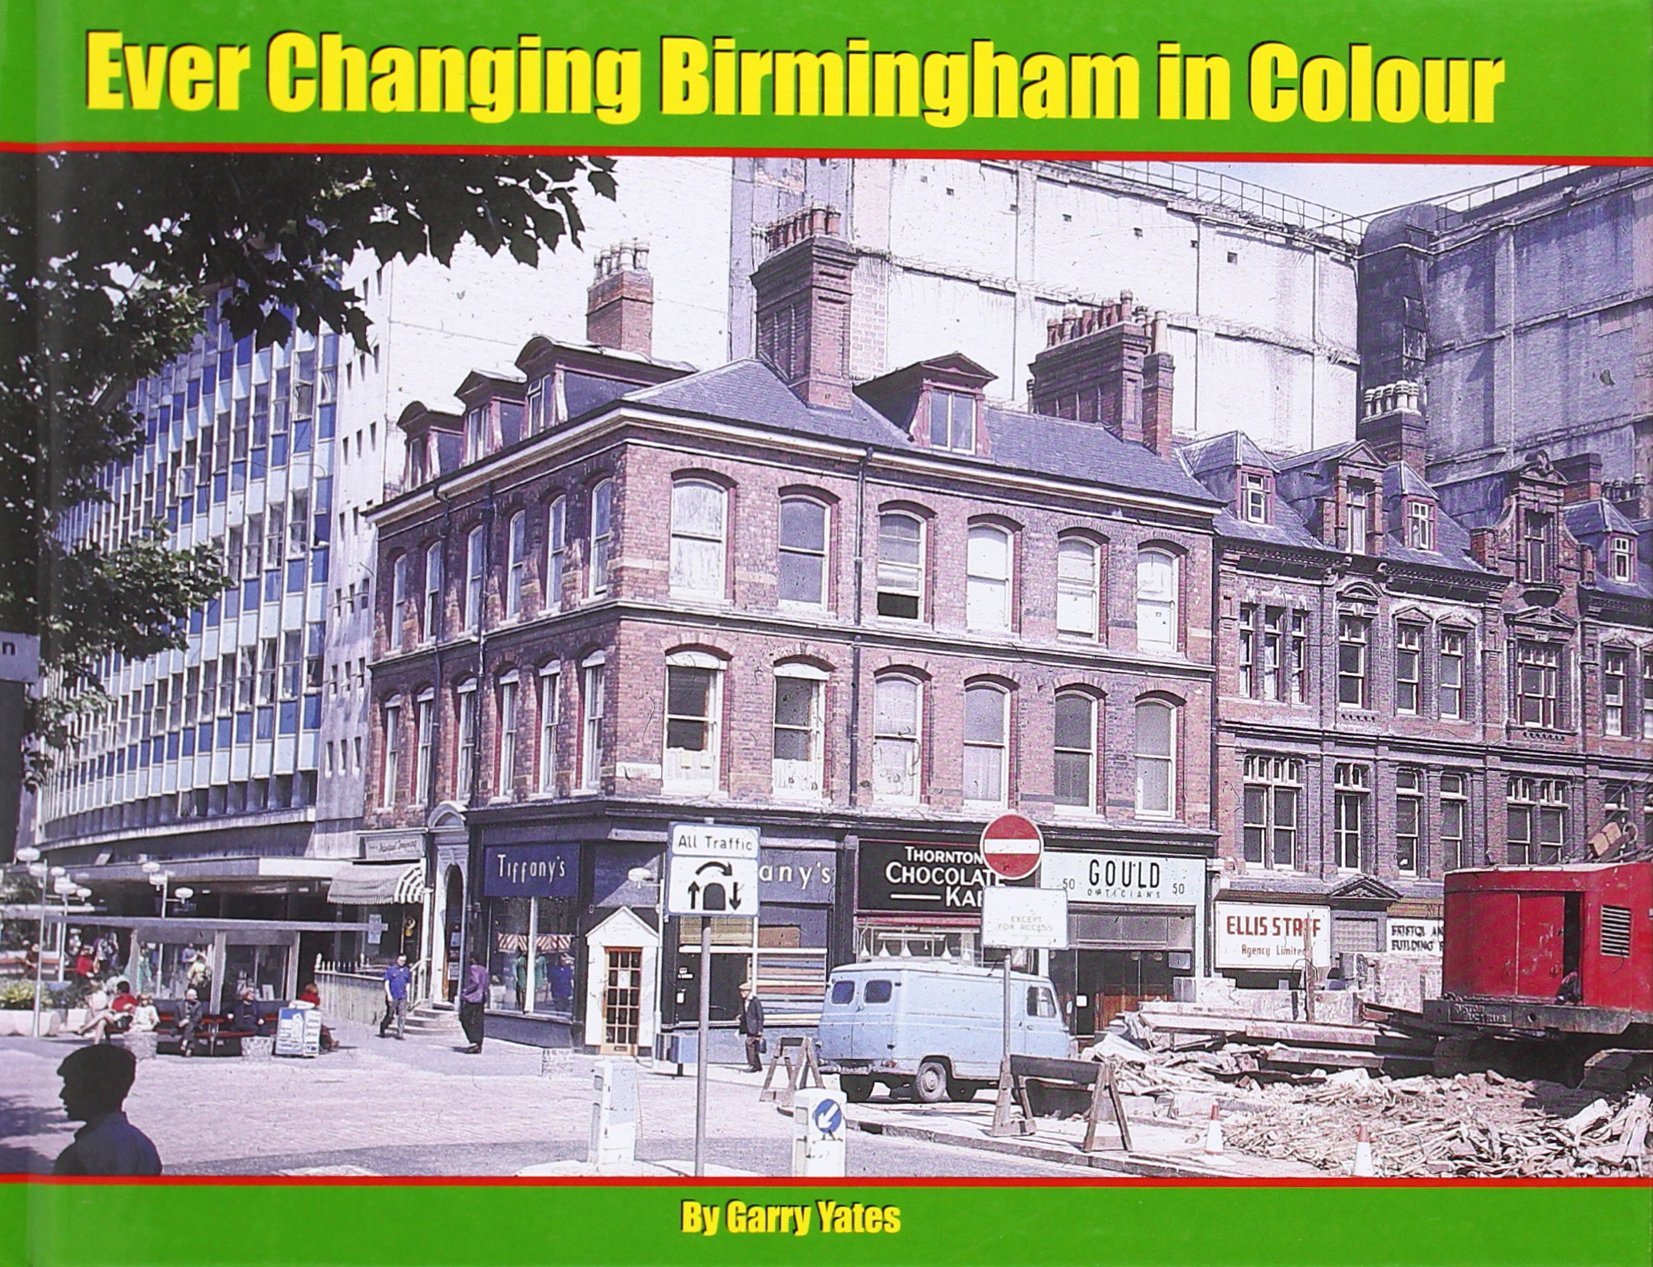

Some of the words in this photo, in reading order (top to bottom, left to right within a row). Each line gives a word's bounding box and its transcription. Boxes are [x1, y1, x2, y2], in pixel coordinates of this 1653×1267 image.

[86, 30, 251, 111] Ever
[266, 33, 642, 124] Changing
[660, 37, 1141, 128] Birmingham
[1158, 42, 1231, 121] in
[1250, 42, 1507, 124] Colour
[677, 834, 698, 849] All
[704, 835, 753, 852] Traffic
[496, 854, 567, 883] Tiffany's
[1088, 858, 1161, 889] GOULD
[1062, 878, 1076, 890] 50
[1172, 883, 1185, 895] 50
[998, 923, 1015, 931] FOR
[1010, 915, 1042, 924] EXCEPT
[1226, 915, 1268, 936] ELLIS
[1241, 943, 1271, 958] Agency
[680, 1199, 722, 1237] By
[725, 1199, 812, 1237] Garry
[816, 1200, 902, 1235] Yates
